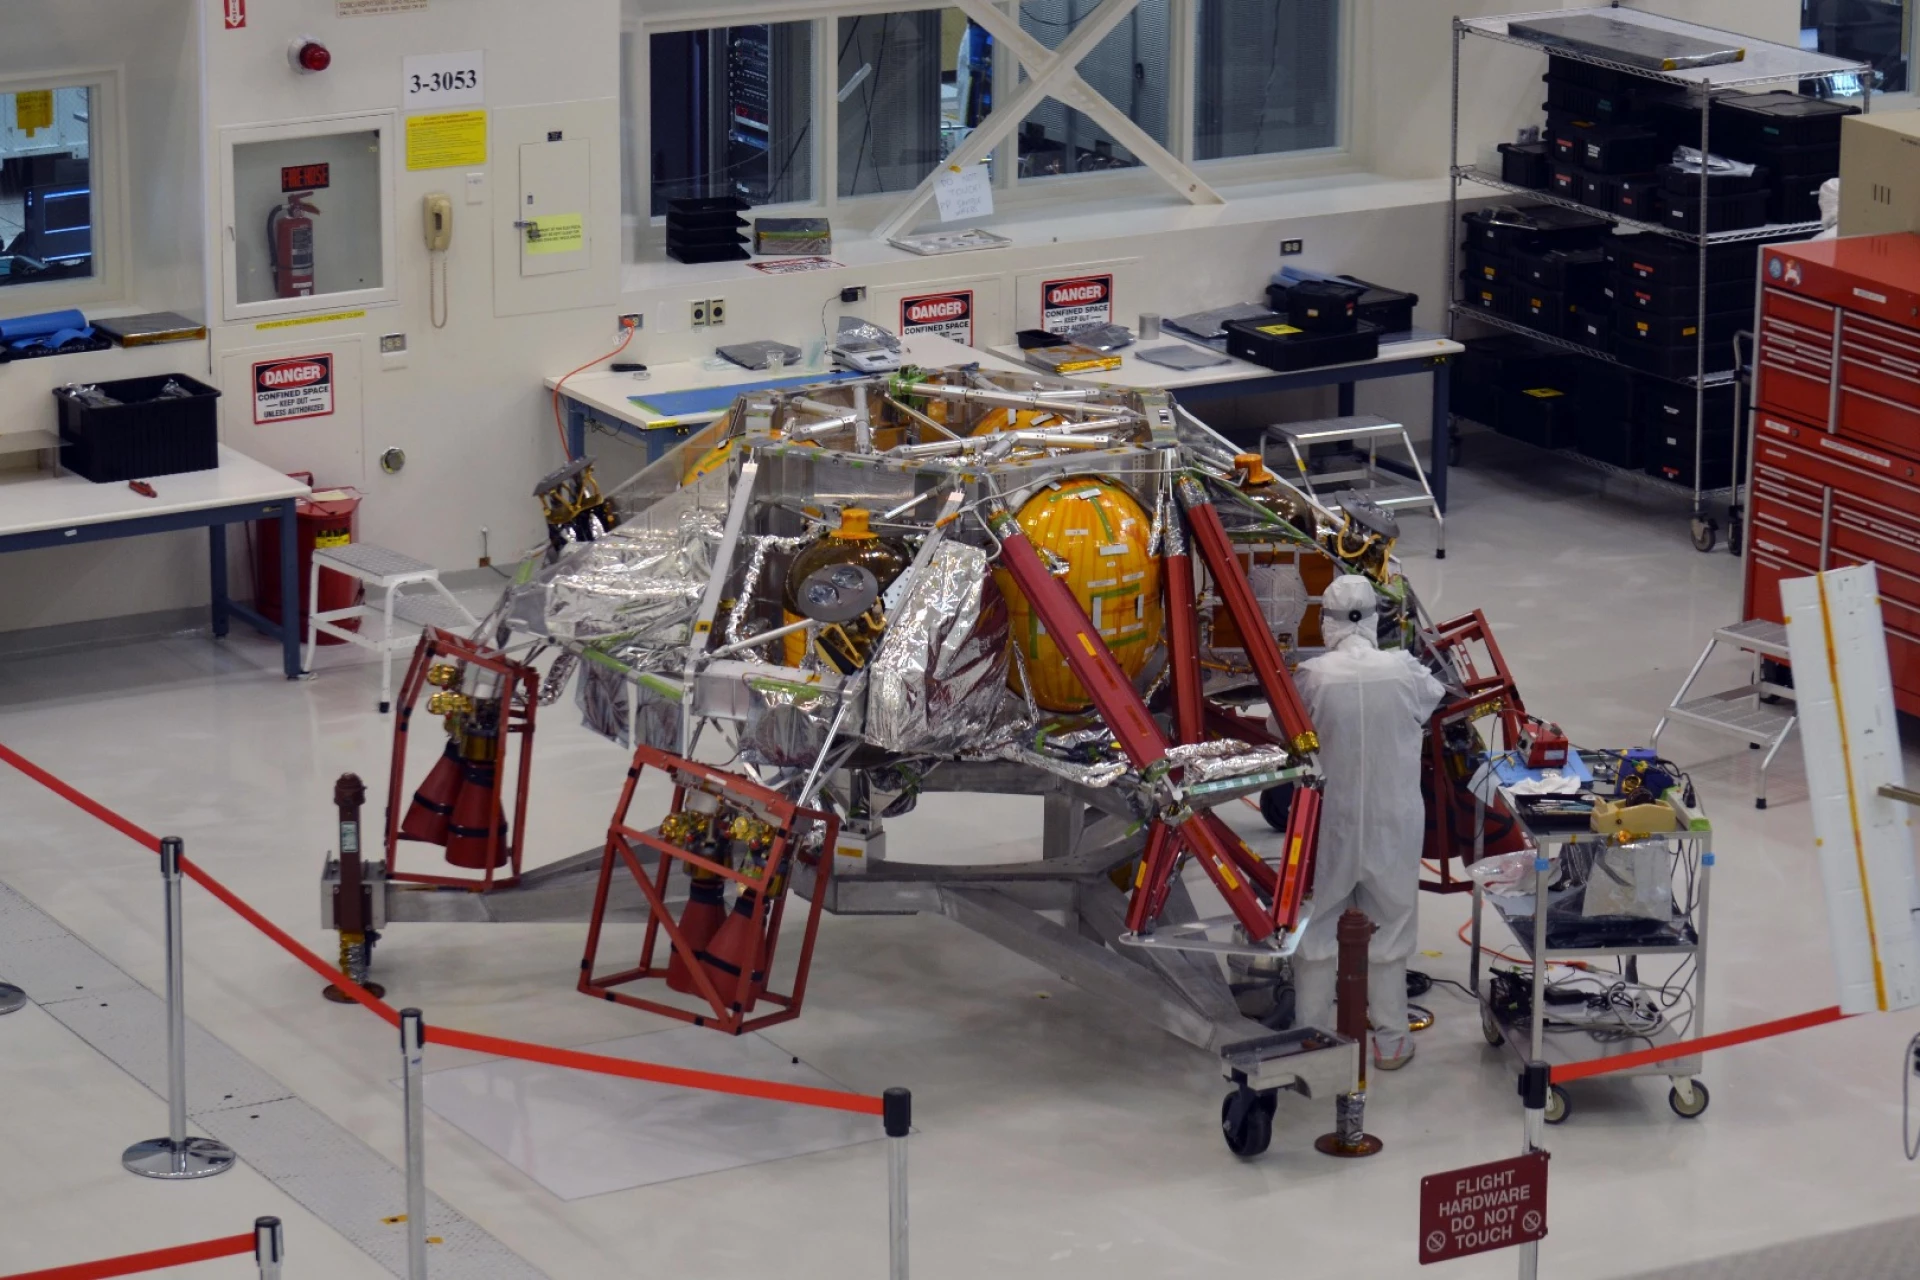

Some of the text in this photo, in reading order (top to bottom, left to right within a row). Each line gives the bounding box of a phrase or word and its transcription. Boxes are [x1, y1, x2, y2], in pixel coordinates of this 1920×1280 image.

[410, 69, 477, 94] 3-3053
[283, 165, 328, 189] FIRE HOSE
[940, 179, 954, 188] DO
[1053, 285, 1102, 303] DANGER
[911, 301, 962, 320] DANGER
[1045, 304, 1108, 318] CONFINED SPACE
[904, 320, 969, 335] CONFINED SPACE
[1064, 316, 1078, 324] KEEP
[264, 365, 321, 386] DANGER
[257, 385, 329, 401] CONFINED SPACE
[264, 403, 325, 418] UNLESS AUTHORIZED
[279, 399, 295, 407] KEEP
[1456, 1170, 1516, 1196] FLIGHT
[1439, 1185, 1530, 1217] HARDWARE
[1451, 1205, 1518, 1233] DO NOT
[1455, 1224, 1513, 1250] TOUCH
